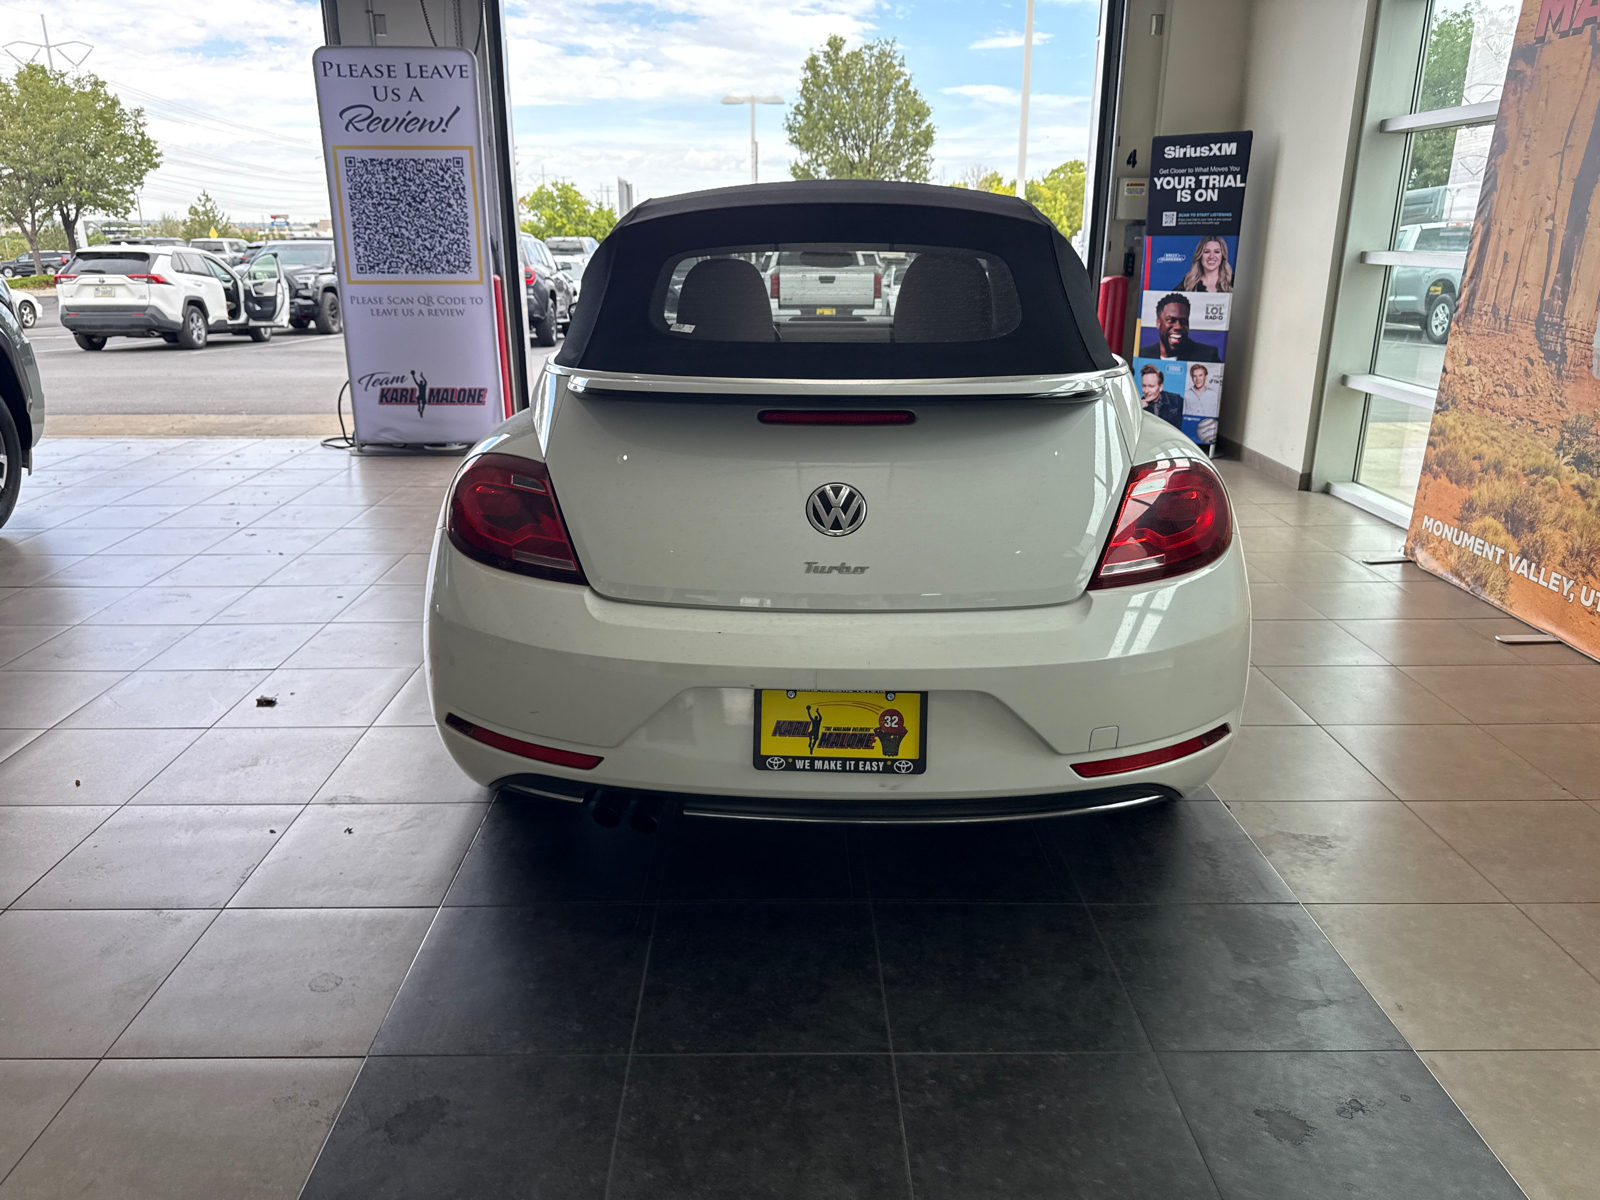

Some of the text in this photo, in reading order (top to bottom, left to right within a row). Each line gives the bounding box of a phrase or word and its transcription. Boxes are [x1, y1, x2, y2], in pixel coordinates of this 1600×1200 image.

[320, 60, 469, 79] PLEASE LEAVE
[408, 86, 425, 102] A
[338, 104, 461, 133] Review!
[1126, 149, 1138, 168] 4
[1163, 142, 1238, 159] SiriusXM
[1153, 174, 1246, 190] YOUR TRIAL
[1176, 188, 1219, 202] IS ON
[417, 295, 435, 307] QR
[370, 308, 466, 316] LEAVE US A REVIEW
[1205, 306, 1224, 315] LOL
[358, 371, 408, 392] Team
[378, 387, 488, 405] KARL MALONE
[1421, 514, 1505, 565] MONUMENT
[1508, 552, 1575, 603] VALLEY,
[804, 562, 870, 574] Turbo
[772, 720, 812, 737] KARL
[884, 716, 899, 728] 32
[818, 732, 876, 749] MALONE
[795, 759, 884, 772] WE MAKE IT EASY
